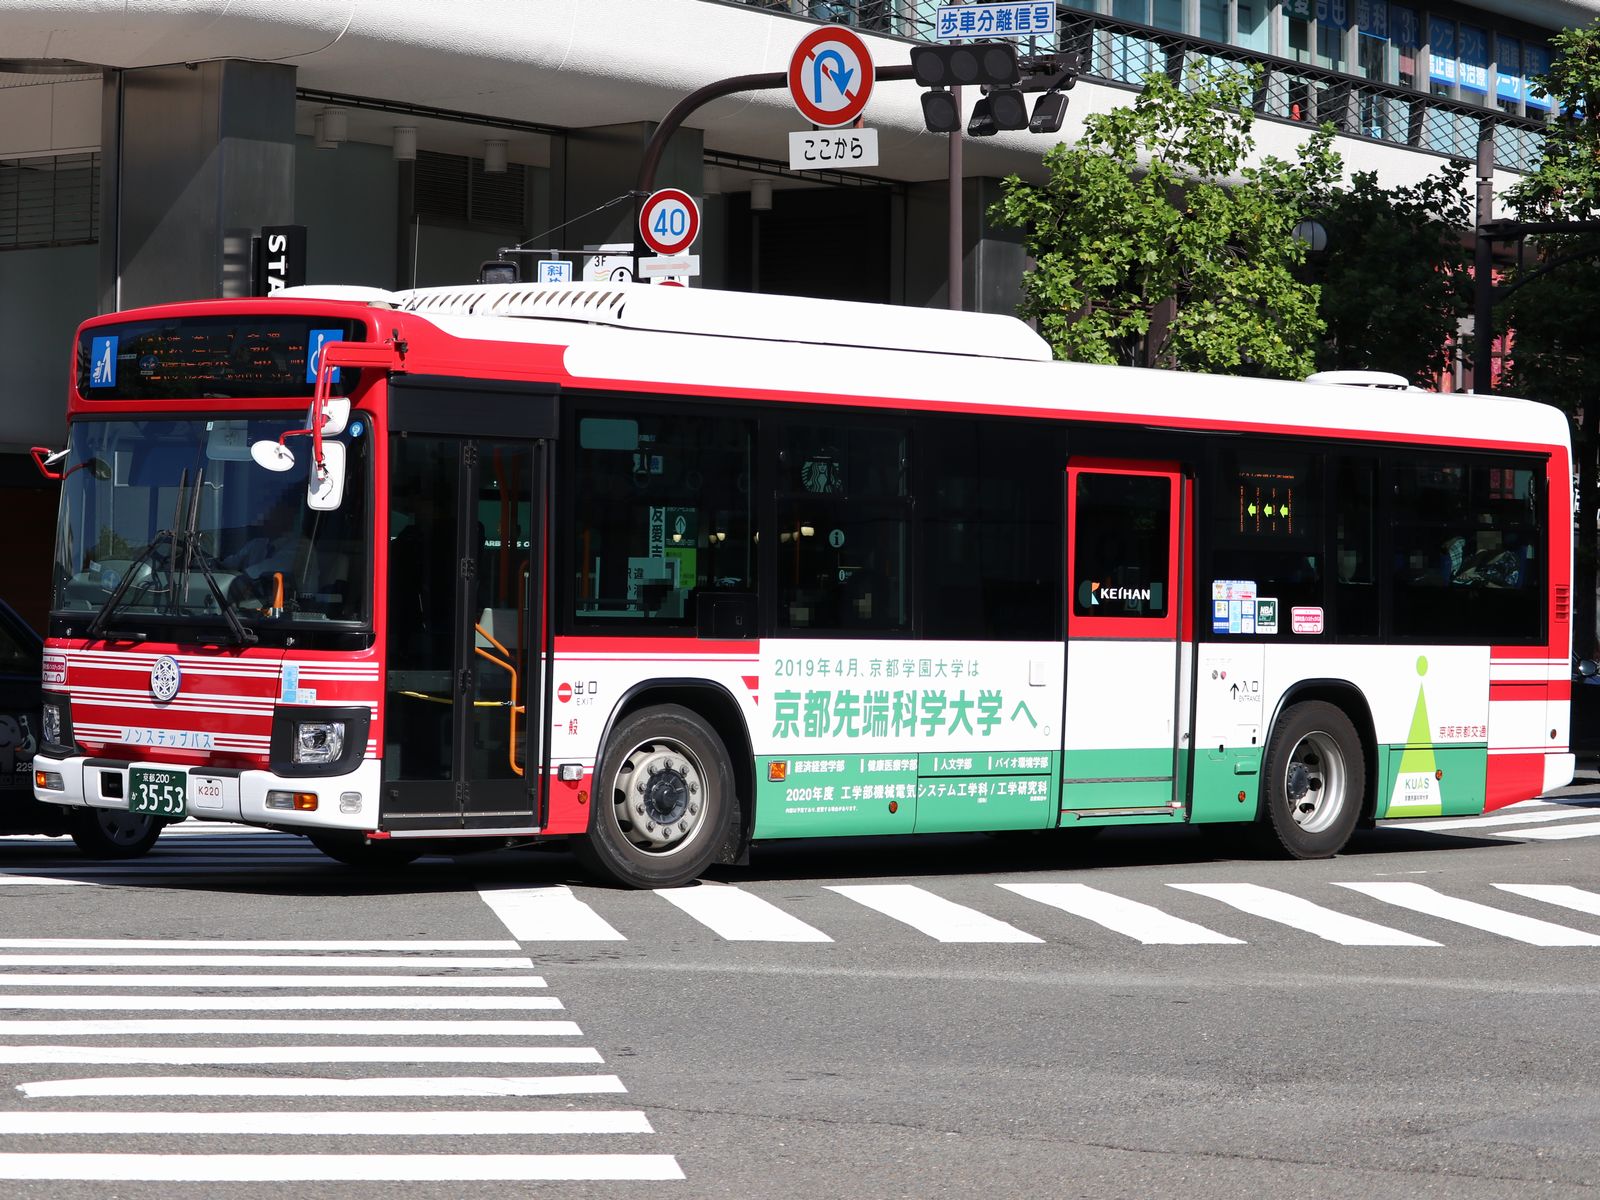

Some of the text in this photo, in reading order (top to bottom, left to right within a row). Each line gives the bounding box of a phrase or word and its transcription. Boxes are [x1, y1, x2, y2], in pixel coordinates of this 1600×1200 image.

[941, 7, 1050, 35] 歩車分離信号
[804, 137, 863, 160] ここから
[654, 208, 685, 236] 40
[594, 255, 607, 267] 3F
[1100, 587, 1151, 600] KEIHAN
[774, 657, 980, 679] 2019年4月、京都学園大学は
[574, 681, 597, 695] 出口
[1241, 680, 1259, 692] 入口
[576, 697, 594, 706] EXIT
[554, 718, 578, 735] 一般
[1439, 725, 1487, 738] 京阪京都交通
[125, 728, 211, 748] ノンステップバス
[940, 757, 973, 770] 人文学部
[1405, 777, 1430, 790] KUAS
[198, 786, 220, 797] K220
[786, 786, 834, 802] 2020年度
